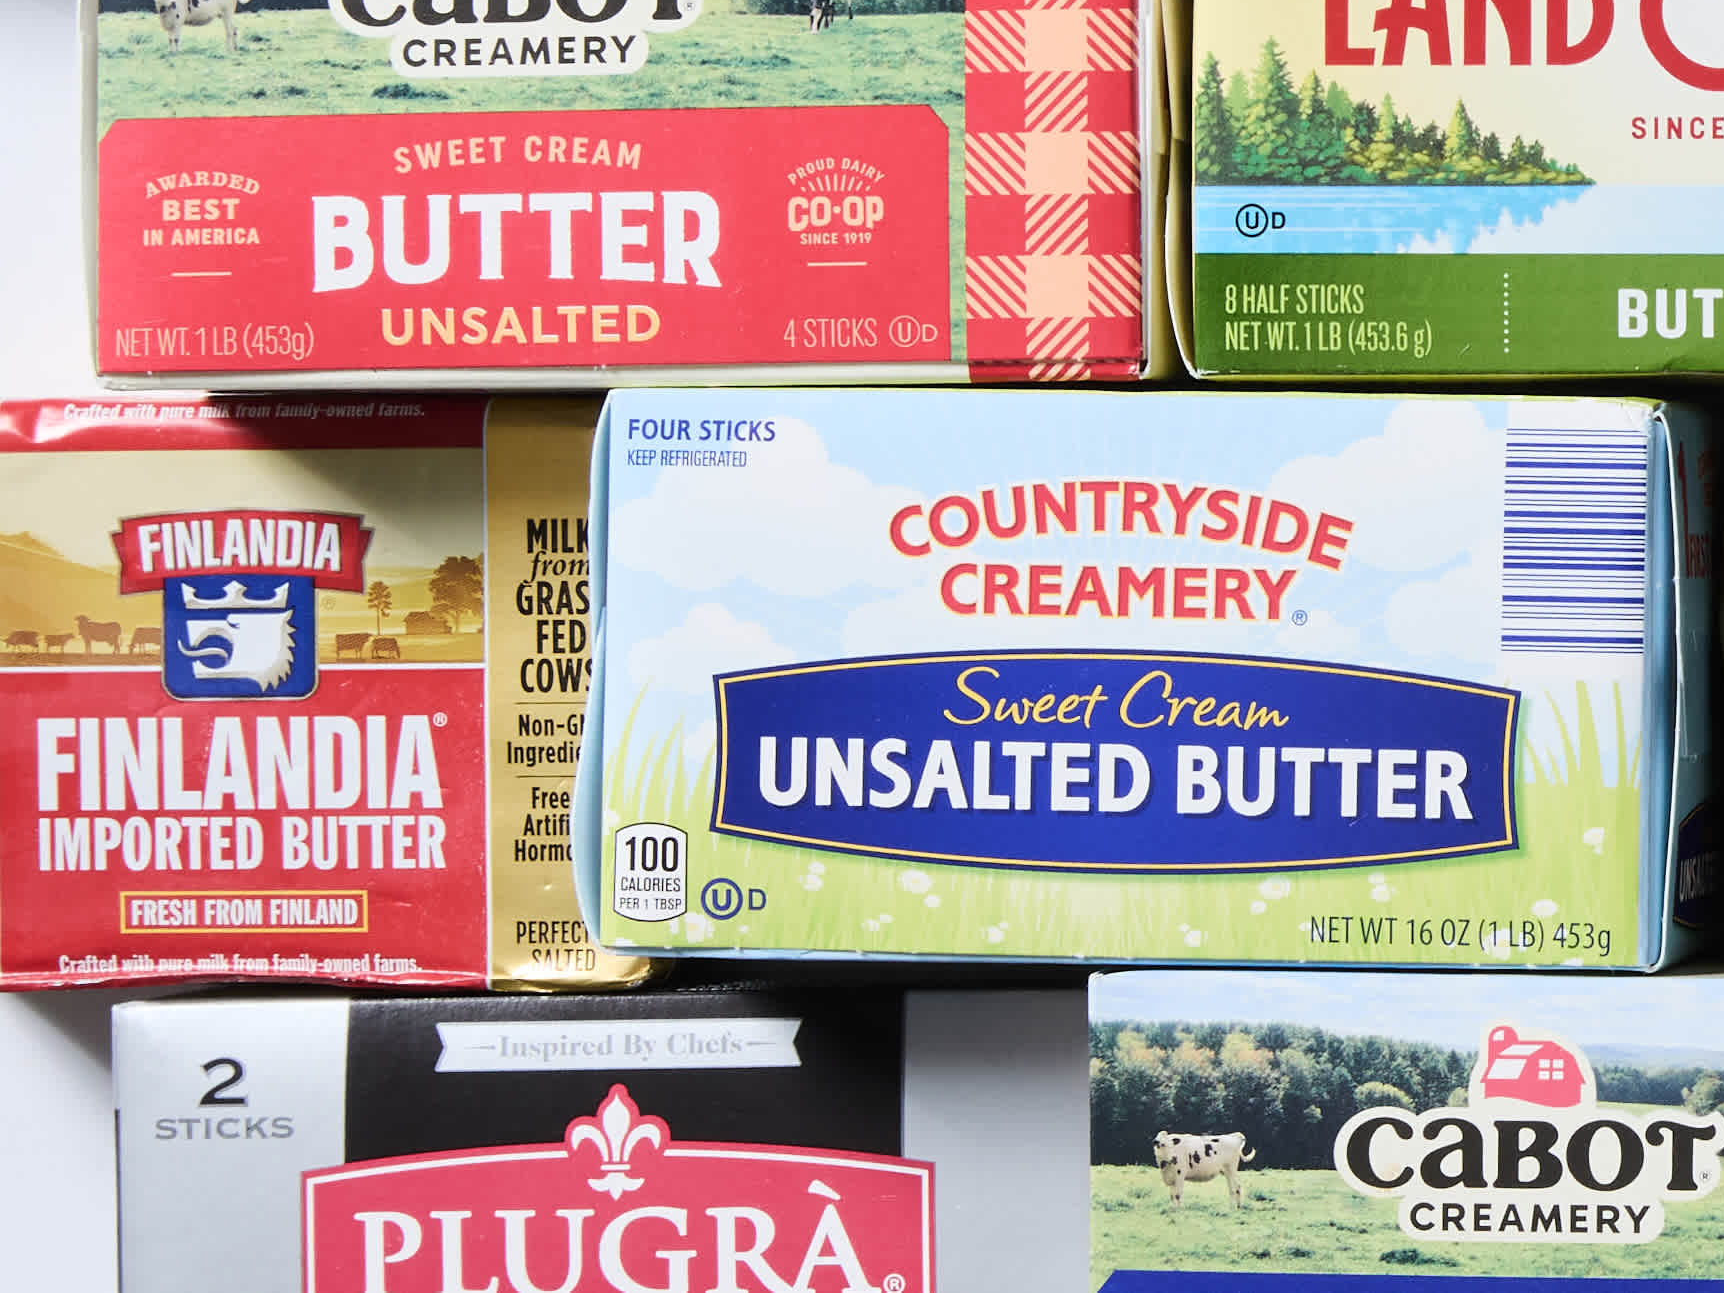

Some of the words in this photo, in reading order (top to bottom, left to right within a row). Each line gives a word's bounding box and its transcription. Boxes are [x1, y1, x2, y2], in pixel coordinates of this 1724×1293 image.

[403, 35, 637, 68] CREAMERY
[394, 135, 507, 173] SWEET
[524, 135, 642, 171] CREAM
[144, 171, 260, 198] AWARDED
[162, 199, 240, 222] BEST
[143, 229, 163, 246] IN
[170, 227, 260, 246] AMERICA
[312, 190, 722, 293] BUTTER
[800, 233, 839, 246] SINCE
[844, 232, 872, 245] 1919
[381, 306, 660, 345] UNSALTED
[526, 518, 589, 554] MILK
[889, 481, 1355, 571] COUNTRYSIDE
[138, 519, 342, 573] FINLANDIA
[940, 563, 1298, 621] CREAMERY
[536, 620, 587, 654] FED
[944, 666, 1108, 727] Sweet
[1118, 669, 1289, 730] Cream
[36, 713, 445, 813] FINLANDIA
[759, 736, 1152, 813] UNSALTED
[1177, 744, 1474, 821] BUTTER
[39, 817, 263, 872] IMPORTED
[283, 814, 446, 871] BUTTER
[131, 899, 198, 927] FRESH
[204, 899, 264, 927] FROM
[271, 898, 358, 927] FINLAND
[1310, 915, 1354, 944] NET
[1360, 916, 1398, 945] WT
[1407, 918, 1434, 946] 16
[1441, 919, 1470, 946] OZ
[1479, 918, 1500, 951] (1
[1508, 919, 1545, 953] LB)
[1552, 922, 1612, 956] 453g
[498, 1032, 617, 1061] Inspired
[624, 1032, 658, 1062] By
[667, 1032, 743, 1058] Chefs
[199, 1057, 249, 1107] 2
[154, 1117, 295, 1140] STICKS
[1410, 1201, 1651, 1235] CREAMERY
